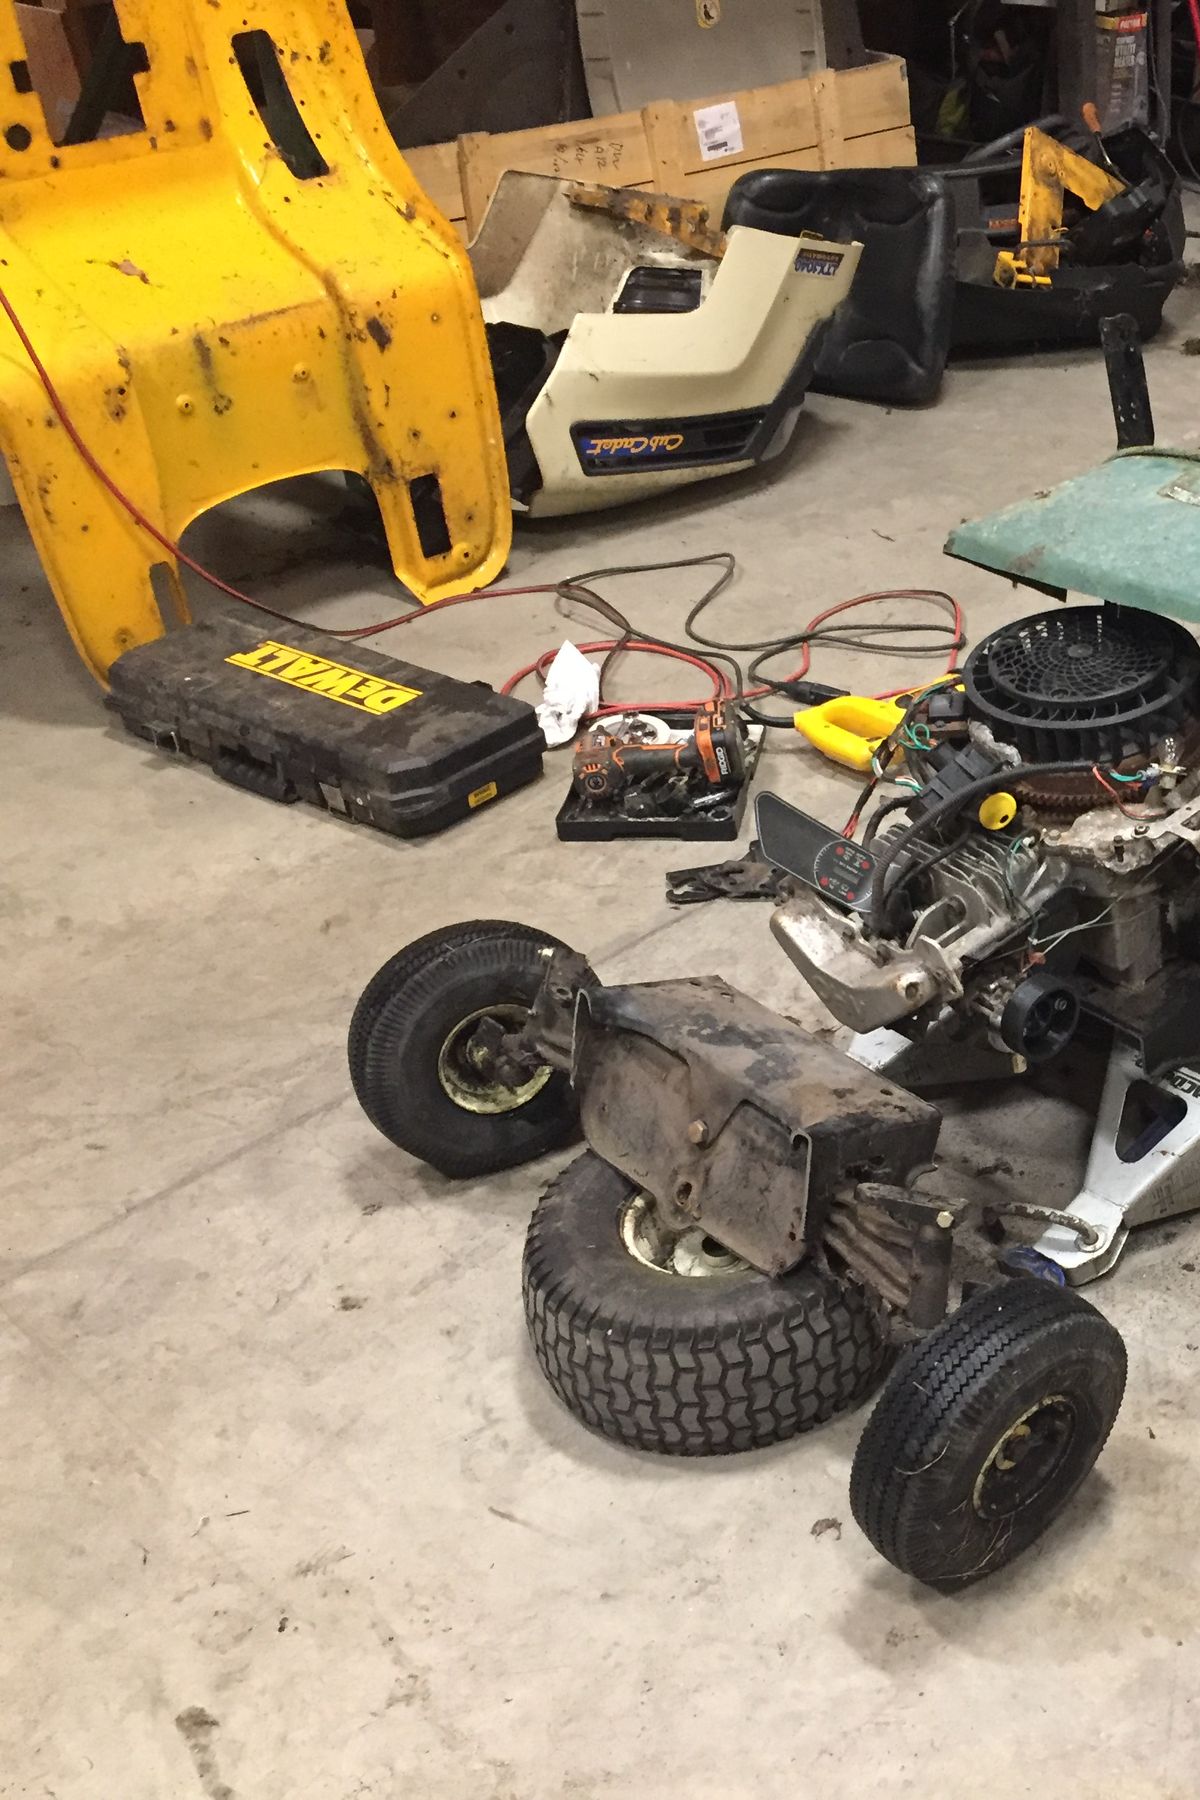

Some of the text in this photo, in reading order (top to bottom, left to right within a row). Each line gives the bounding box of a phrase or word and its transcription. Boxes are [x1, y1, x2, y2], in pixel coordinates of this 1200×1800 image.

[586, 434, 684, 455] Cub Cadet
[229, 643, 419, 714] DEWALT
[715, 746, 729, 775] RIDGID
